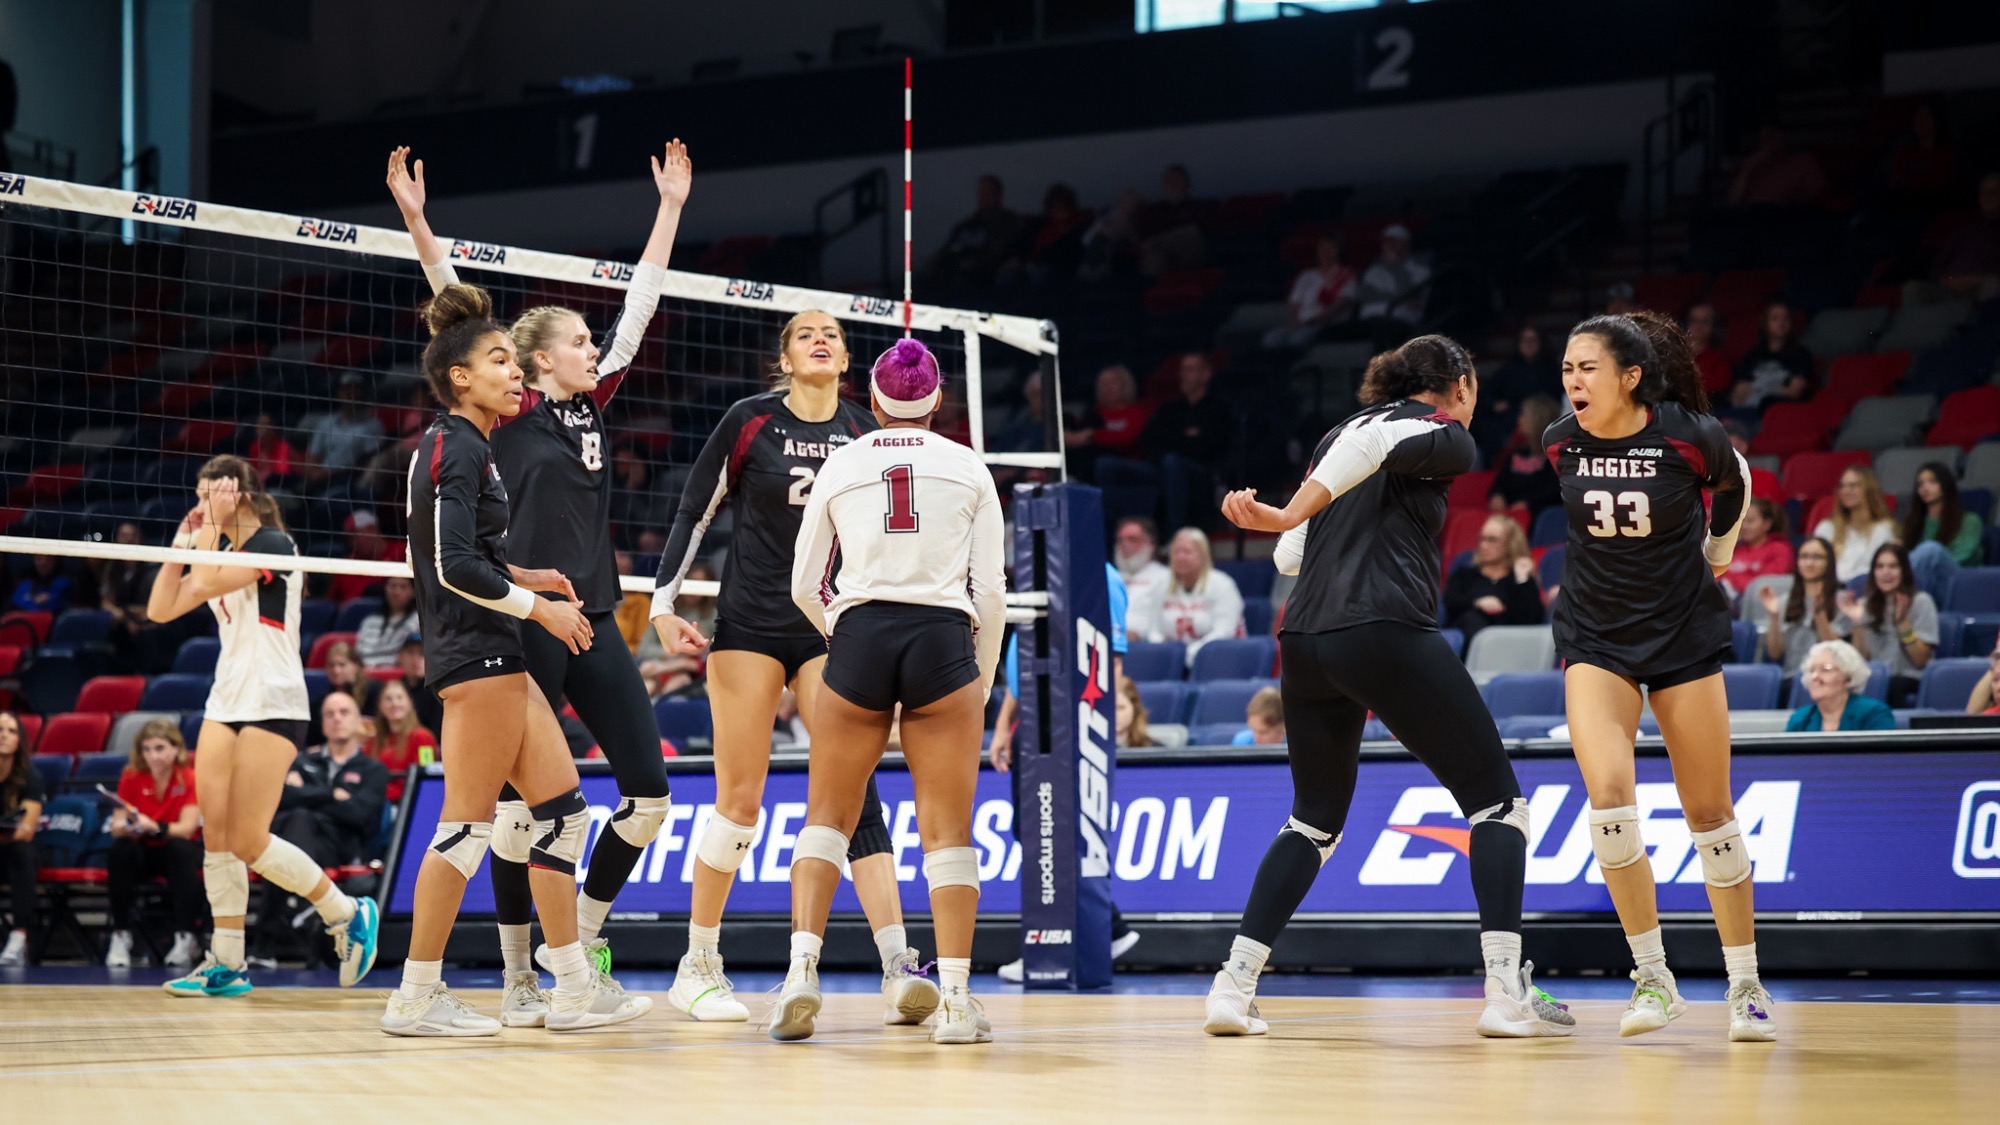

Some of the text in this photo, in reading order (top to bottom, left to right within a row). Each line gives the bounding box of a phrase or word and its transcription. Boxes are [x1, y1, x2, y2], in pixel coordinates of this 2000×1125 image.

[1369, 27, 1414, 89] 2
[573, 112, 599, 170] 1
[581, 431, 603, 471] 8
[872, 437, 924, 448] AGGIES
[788, 466, 817, 506] 2
[1576, 457, 1657, 478] AGGIES
[882, 464, 919, 533] 1
[1583, 489, 1652, 538] 33
[1037, 782, 1056, 905] sports imports
